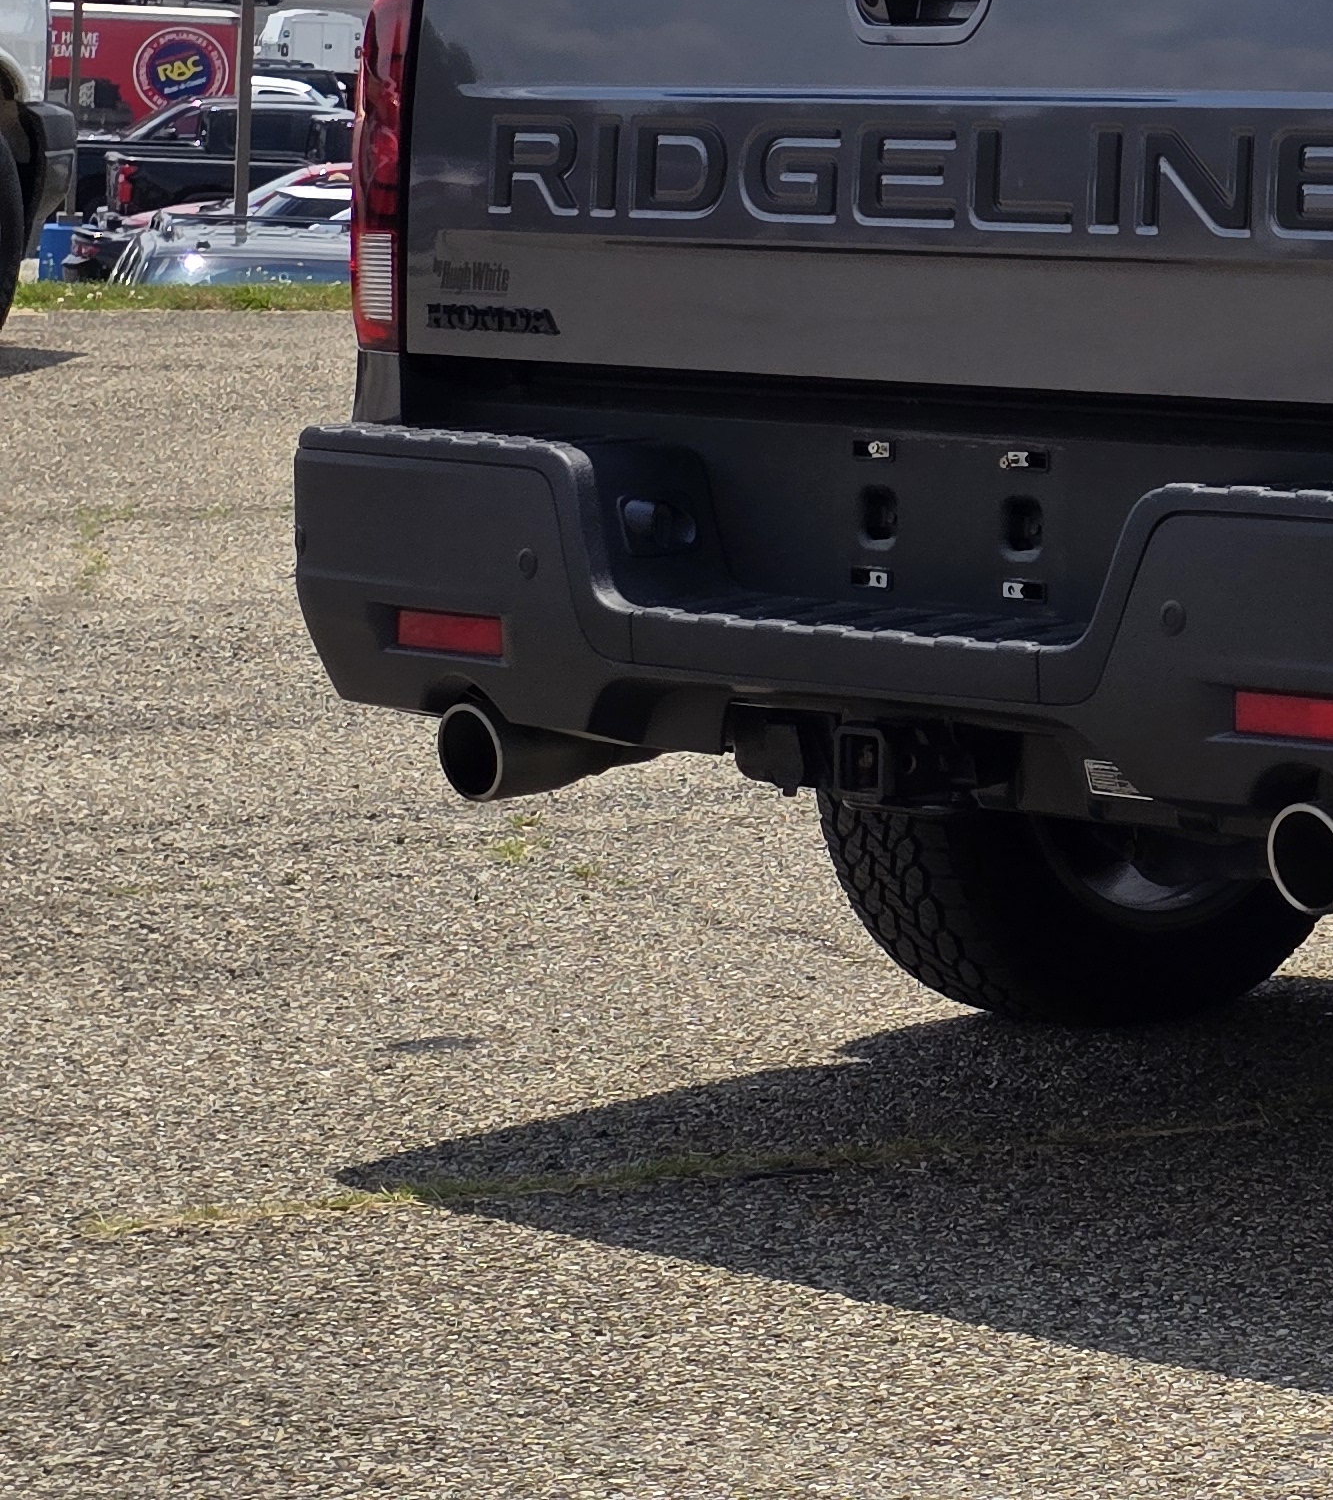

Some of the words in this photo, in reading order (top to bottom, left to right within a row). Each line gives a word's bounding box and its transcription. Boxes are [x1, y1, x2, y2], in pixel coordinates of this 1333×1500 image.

[61, 31, 100, 45] HME
[156, 55, 204, 82] RAC
[426, 303, 561, 336] HONDA
